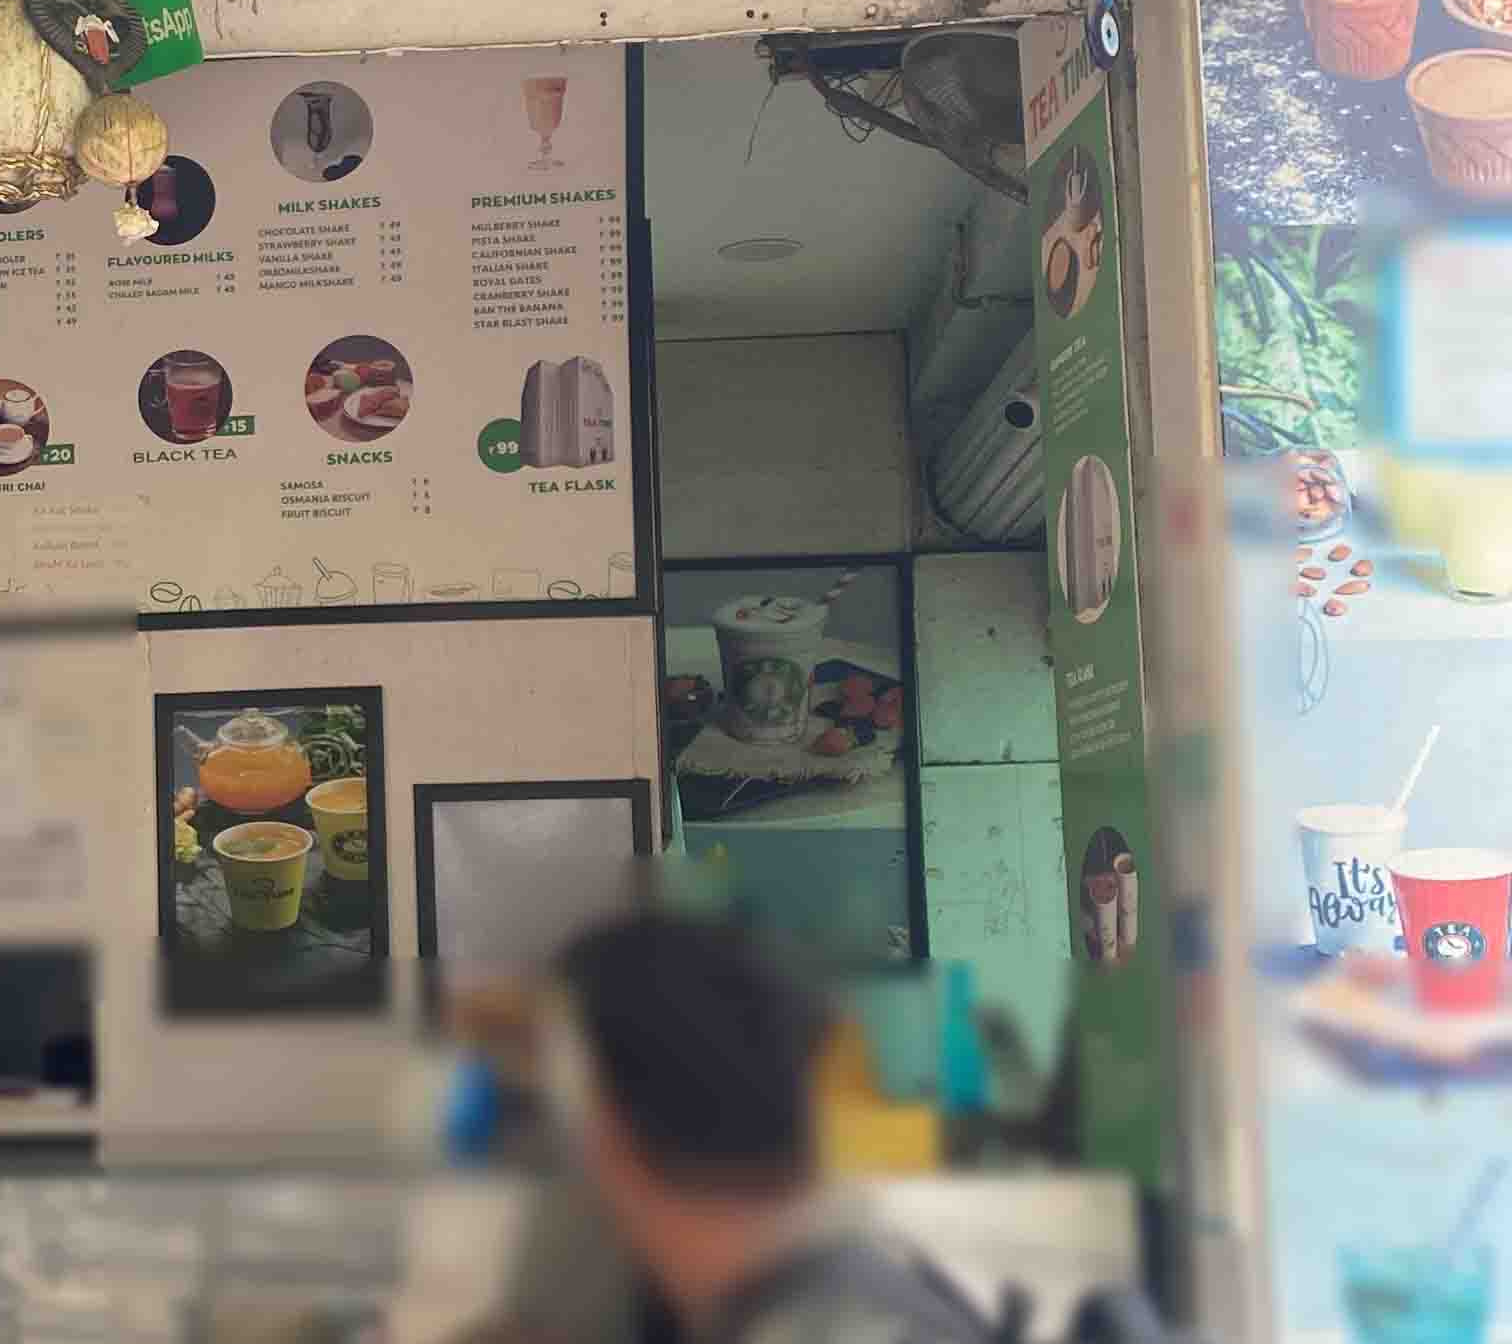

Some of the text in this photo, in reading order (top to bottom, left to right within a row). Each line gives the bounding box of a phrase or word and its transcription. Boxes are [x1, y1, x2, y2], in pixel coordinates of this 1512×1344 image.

[278, 196, 382, 214] MILK SHAKES
[471, 189, 617, 209] PREMIUM SHAKES
[107, 251, 235, 269] FLAVOURED MILKS
[133, 448, 238, 464] BLACK TEA
[327, 451, 394, 466] SNACKS
[529, 479, 616, 494] TEA FLASK
